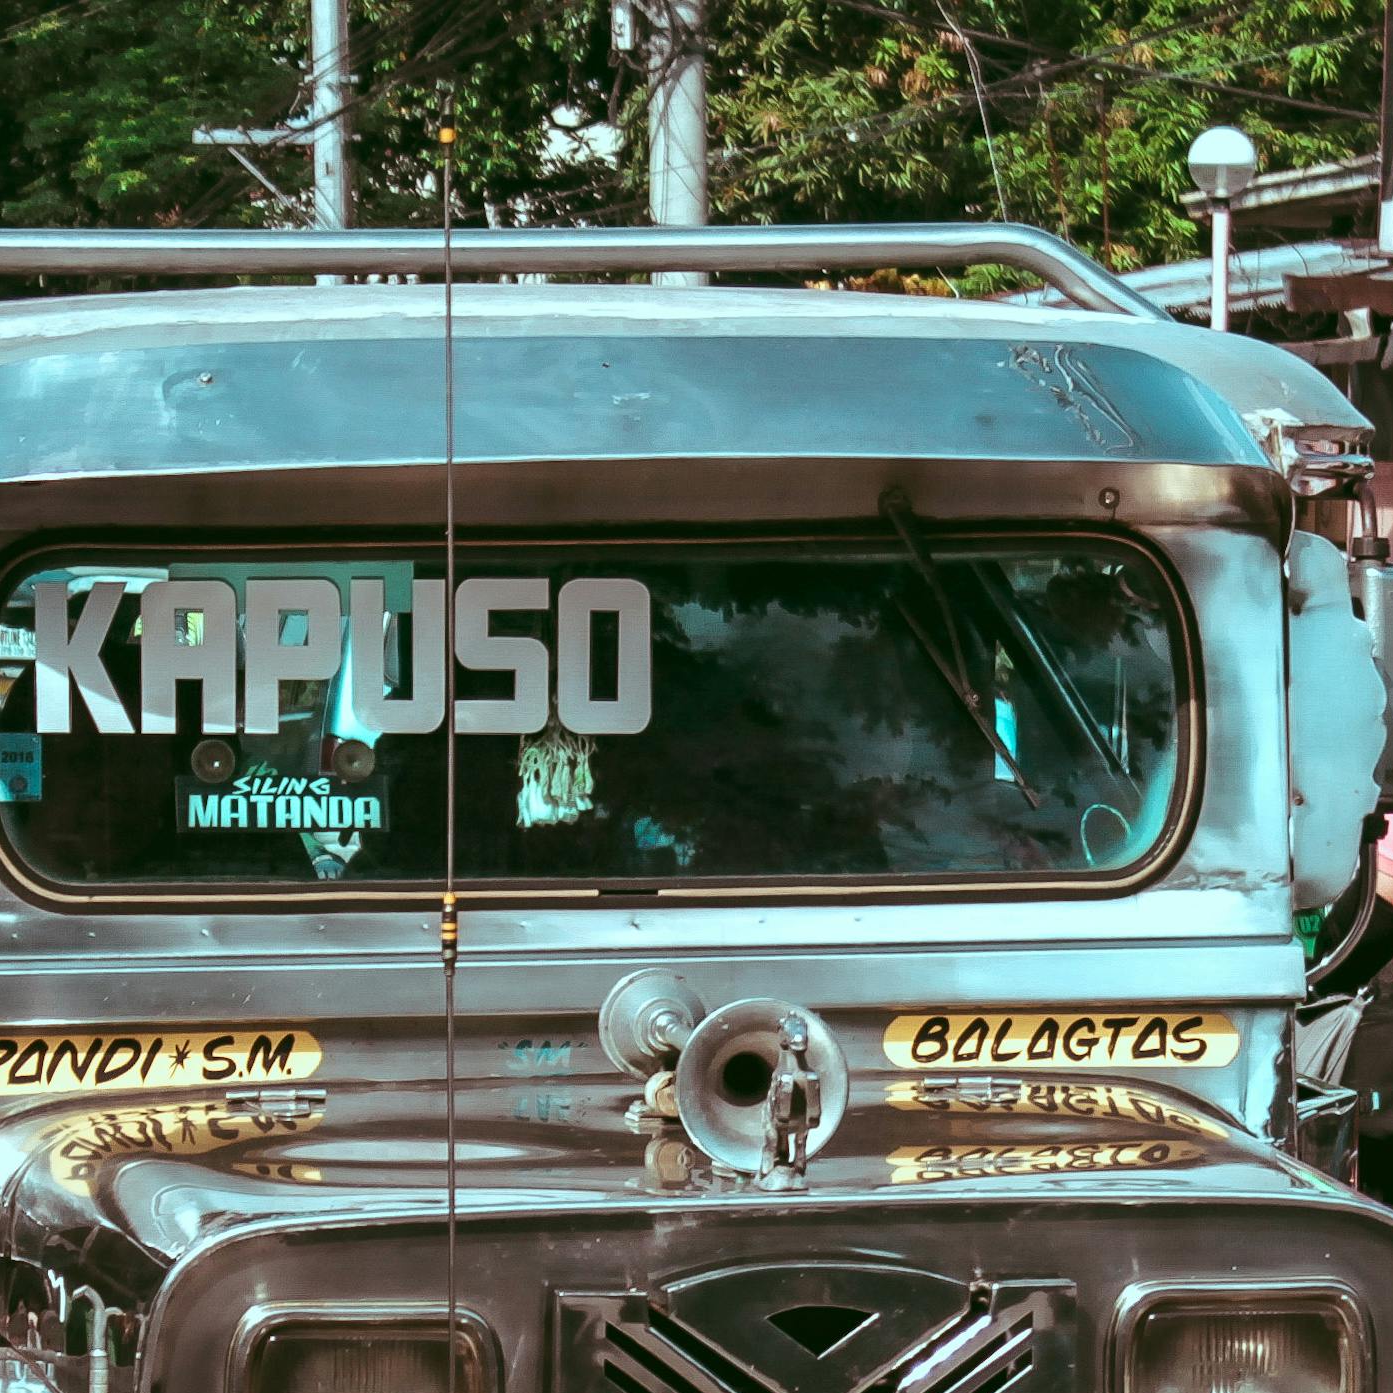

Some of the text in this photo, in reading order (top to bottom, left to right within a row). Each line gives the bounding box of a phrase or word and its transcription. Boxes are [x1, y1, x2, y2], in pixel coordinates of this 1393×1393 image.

[35, 578, 653, 735] KAPUSO
[232, 775, 331, 795] SILING
[187, 794, 382, 829] MATANDA
[202, 1033, 294, 1080] S.M.
[911, 1015, 1208, 1063] BALAGTAS
